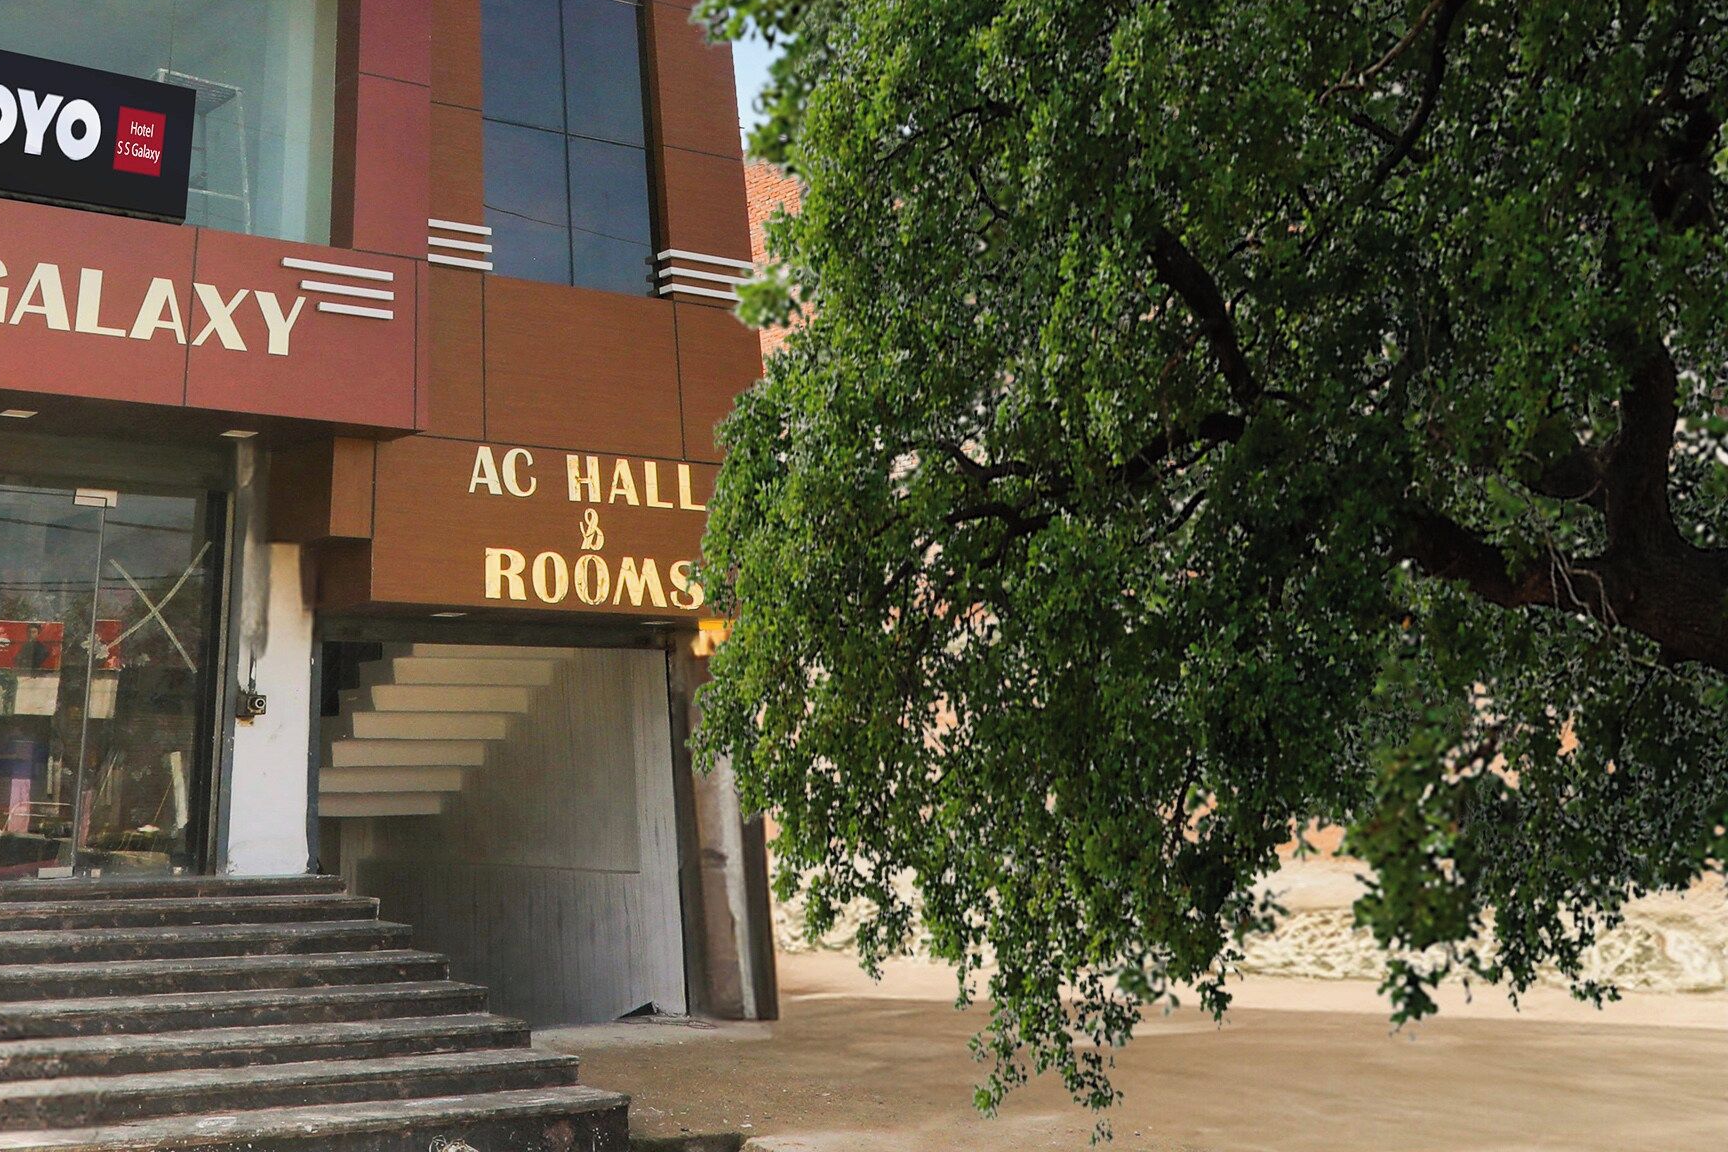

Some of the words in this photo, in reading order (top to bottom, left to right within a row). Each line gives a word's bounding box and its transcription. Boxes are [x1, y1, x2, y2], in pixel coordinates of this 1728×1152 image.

[130, 120, 155, 138] Hotel
[132, 142, 161, 164] Galaxy
[468, 445, 537, 498] AC
[566, 454, 707, 511] HALL
[579, 508, 605, 551] &
[485, 547, 705, 611] ROOMS
